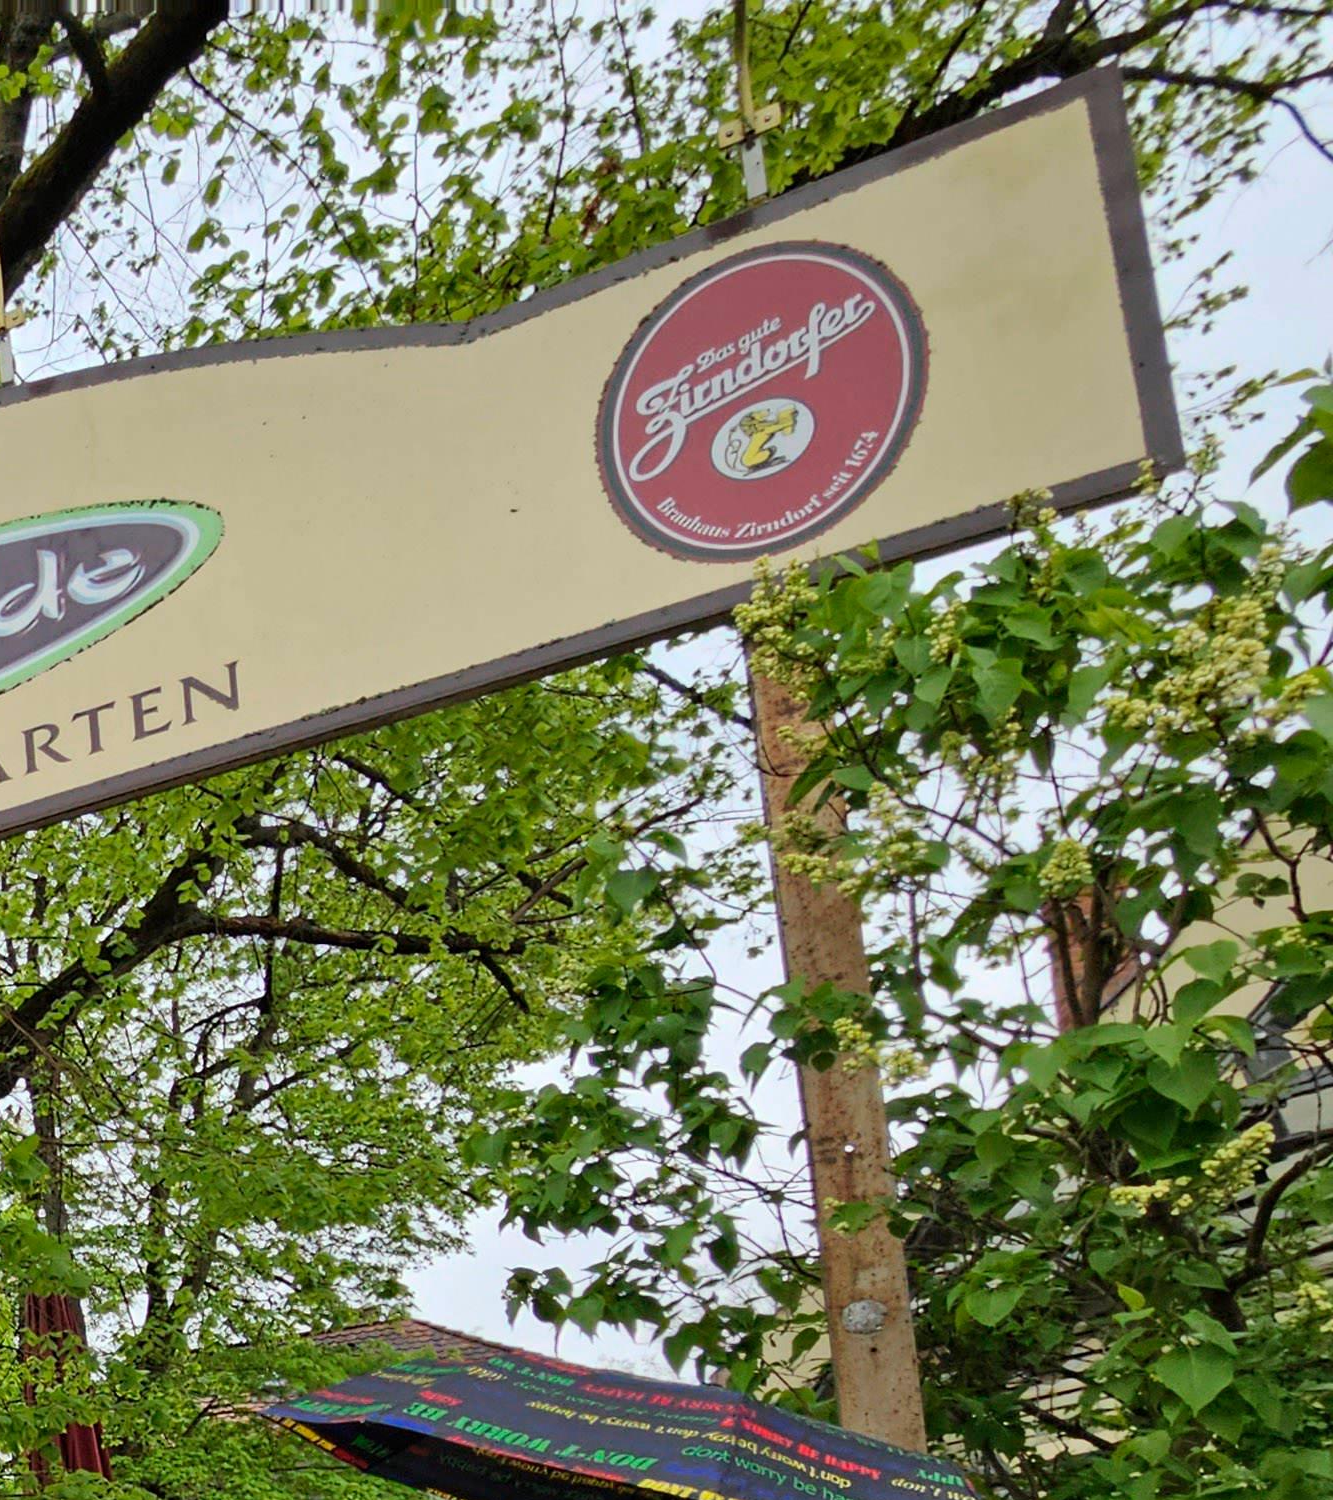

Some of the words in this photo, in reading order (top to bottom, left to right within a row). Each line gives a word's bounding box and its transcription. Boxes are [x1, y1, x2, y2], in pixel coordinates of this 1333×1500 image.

[696, 342, 736, 373] Das
[738, 316, 782, 355] gute
[629, 293, 876, 482] Zirndorfer
[656, 496, 732, 538] Brauhaus
[734, 494, 824, 539] Zirndorf
[823, 472, 854, 500] seit
[844, 430, 880, 467] 1674
[734, 1456, 787, 1486] worry
[792, 1476, 817, 1495] be
